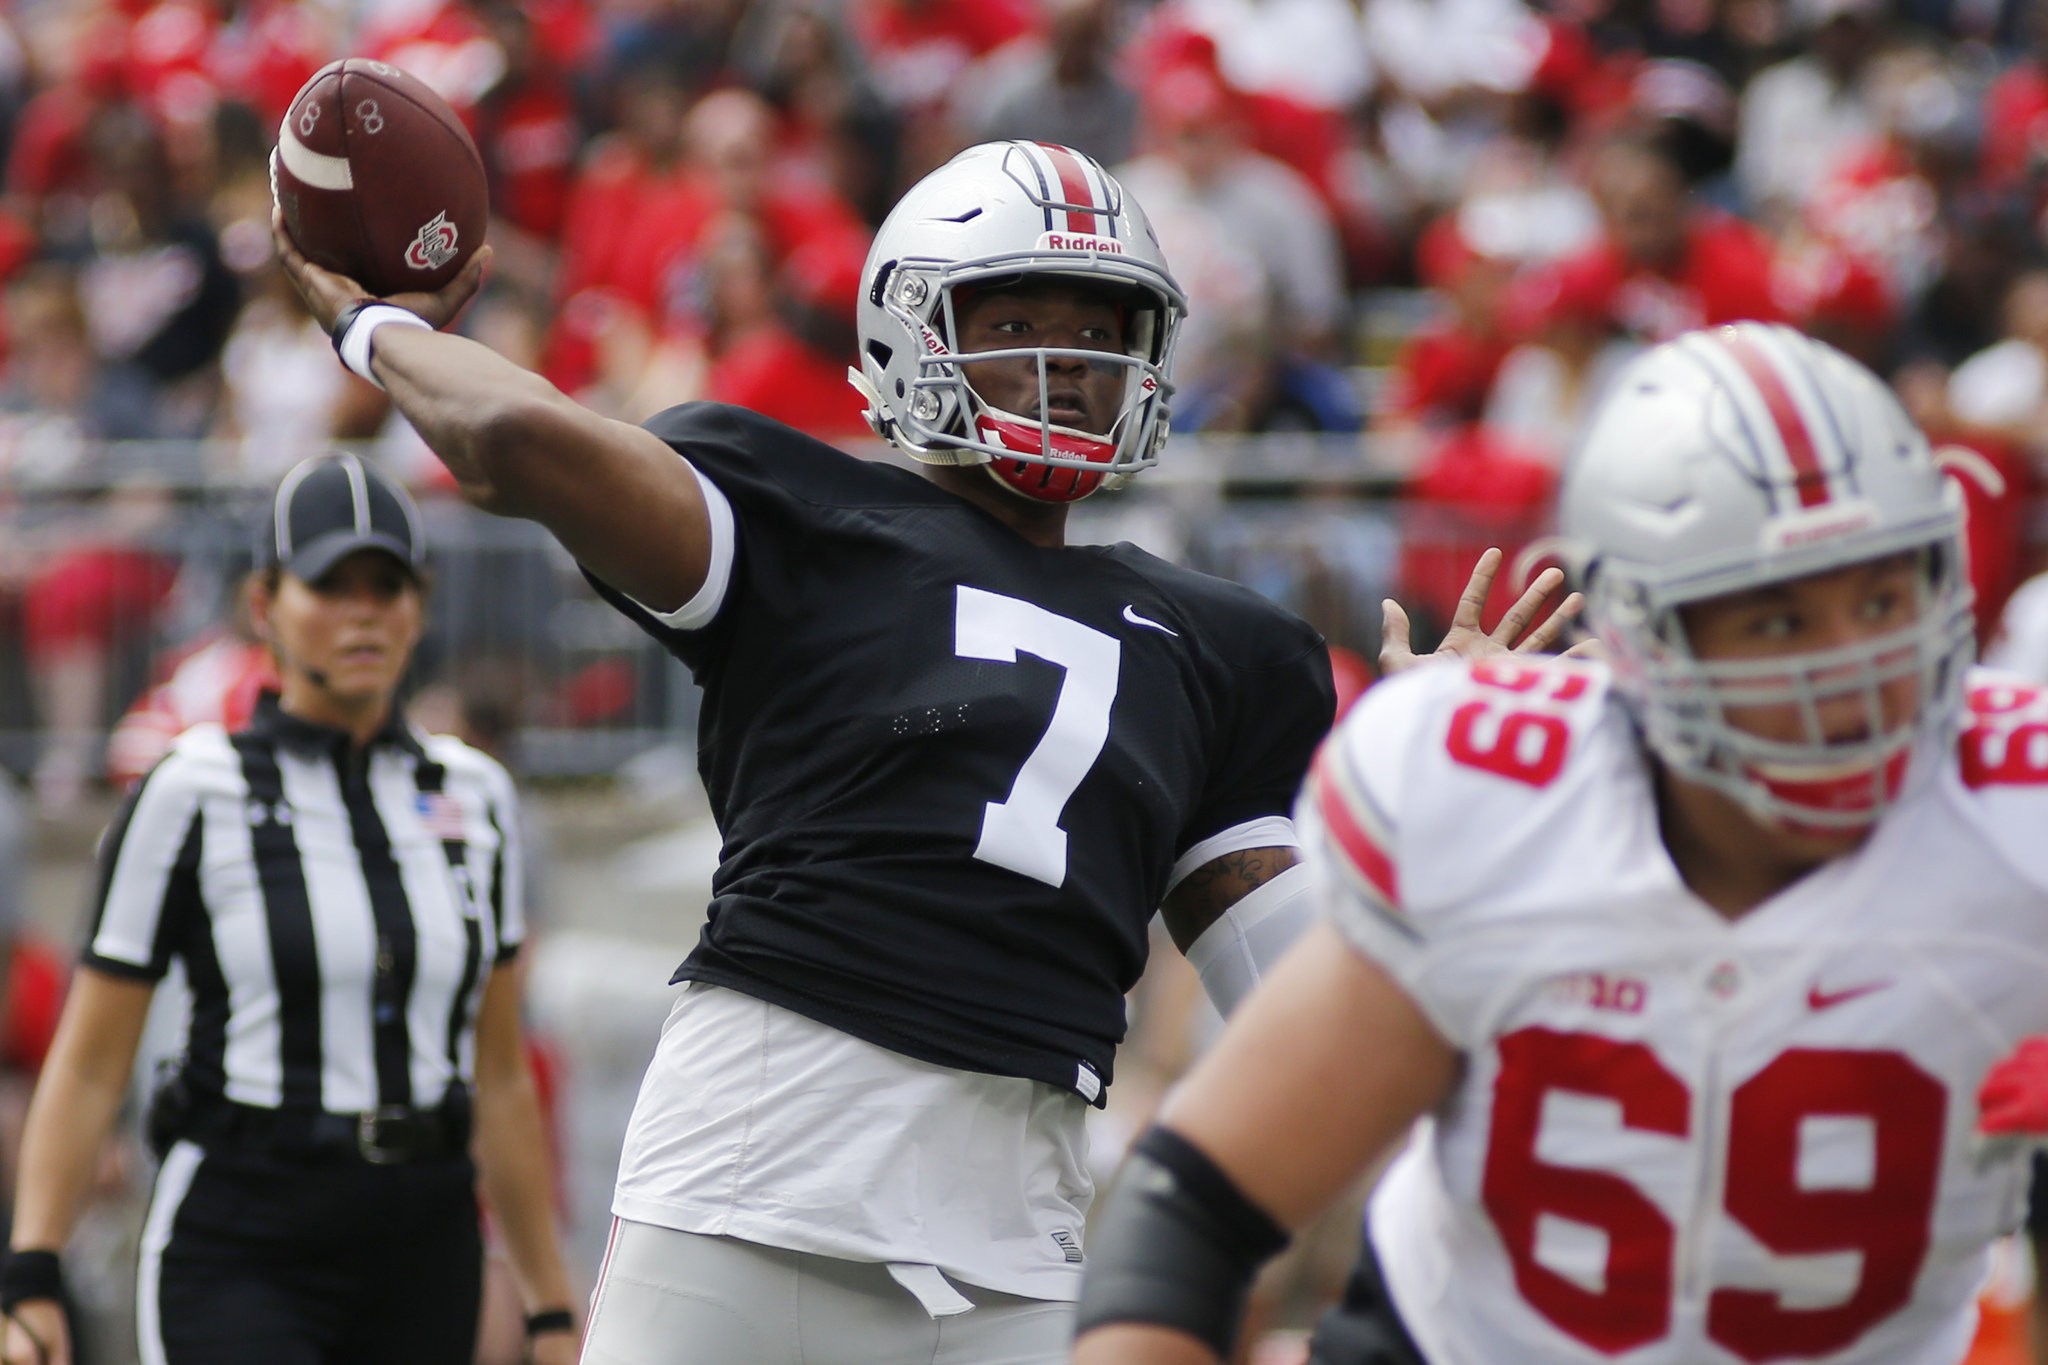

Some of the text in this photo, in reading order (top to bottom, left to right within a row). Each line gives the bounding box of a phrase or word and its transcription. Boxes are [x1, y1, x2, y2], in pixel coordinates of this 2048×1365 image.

[300, 101, 321, 136] 8
[356, 99, 384, 134] 8
[1049, 235, 1122, 254] Riddell
[1050, 448, 1088, 461] Riddell
[955, 584, 1121, 889] 7
[1481, 1025, 1949, 1364] 69
